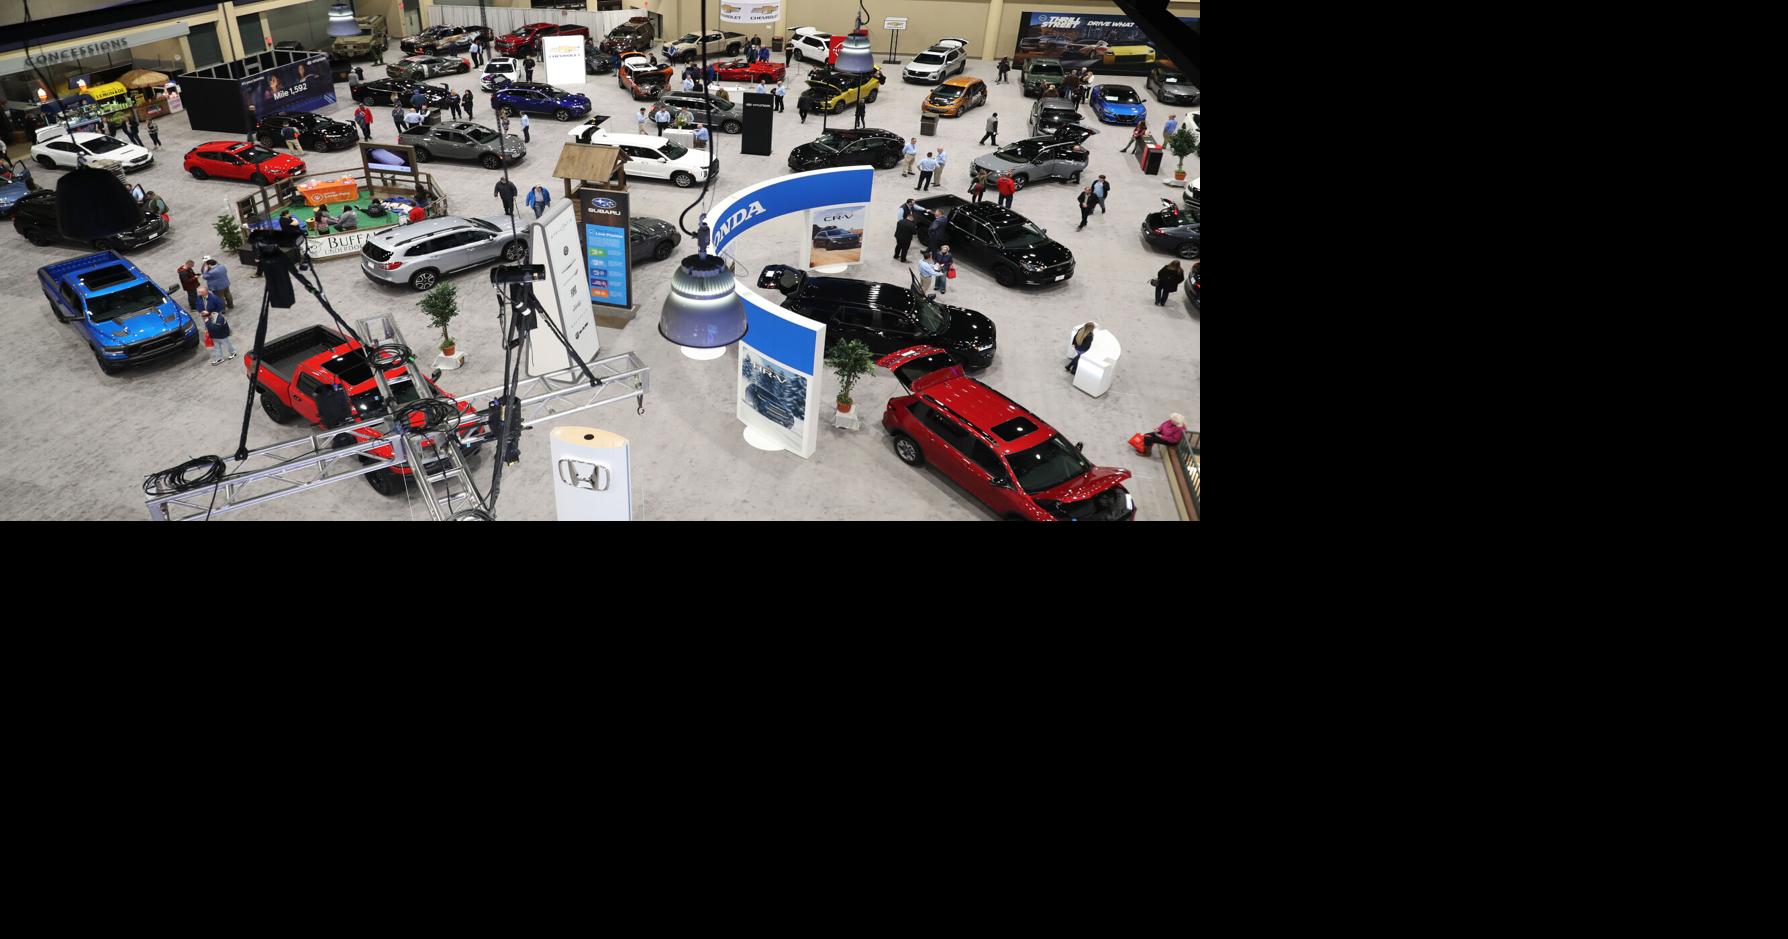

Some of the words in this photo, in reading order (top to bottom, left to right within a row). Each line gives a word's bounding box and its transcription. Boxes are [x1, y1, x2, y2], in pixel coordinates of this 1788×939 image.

[25, 37, 128, 66] CONCESSIONS
[274, 89, 289, 100] Mile
[289, 83, 308, 95] 1,592
[587, 207, 621, 216] SUBARU
[714, 200, 767, 247] ONDA
